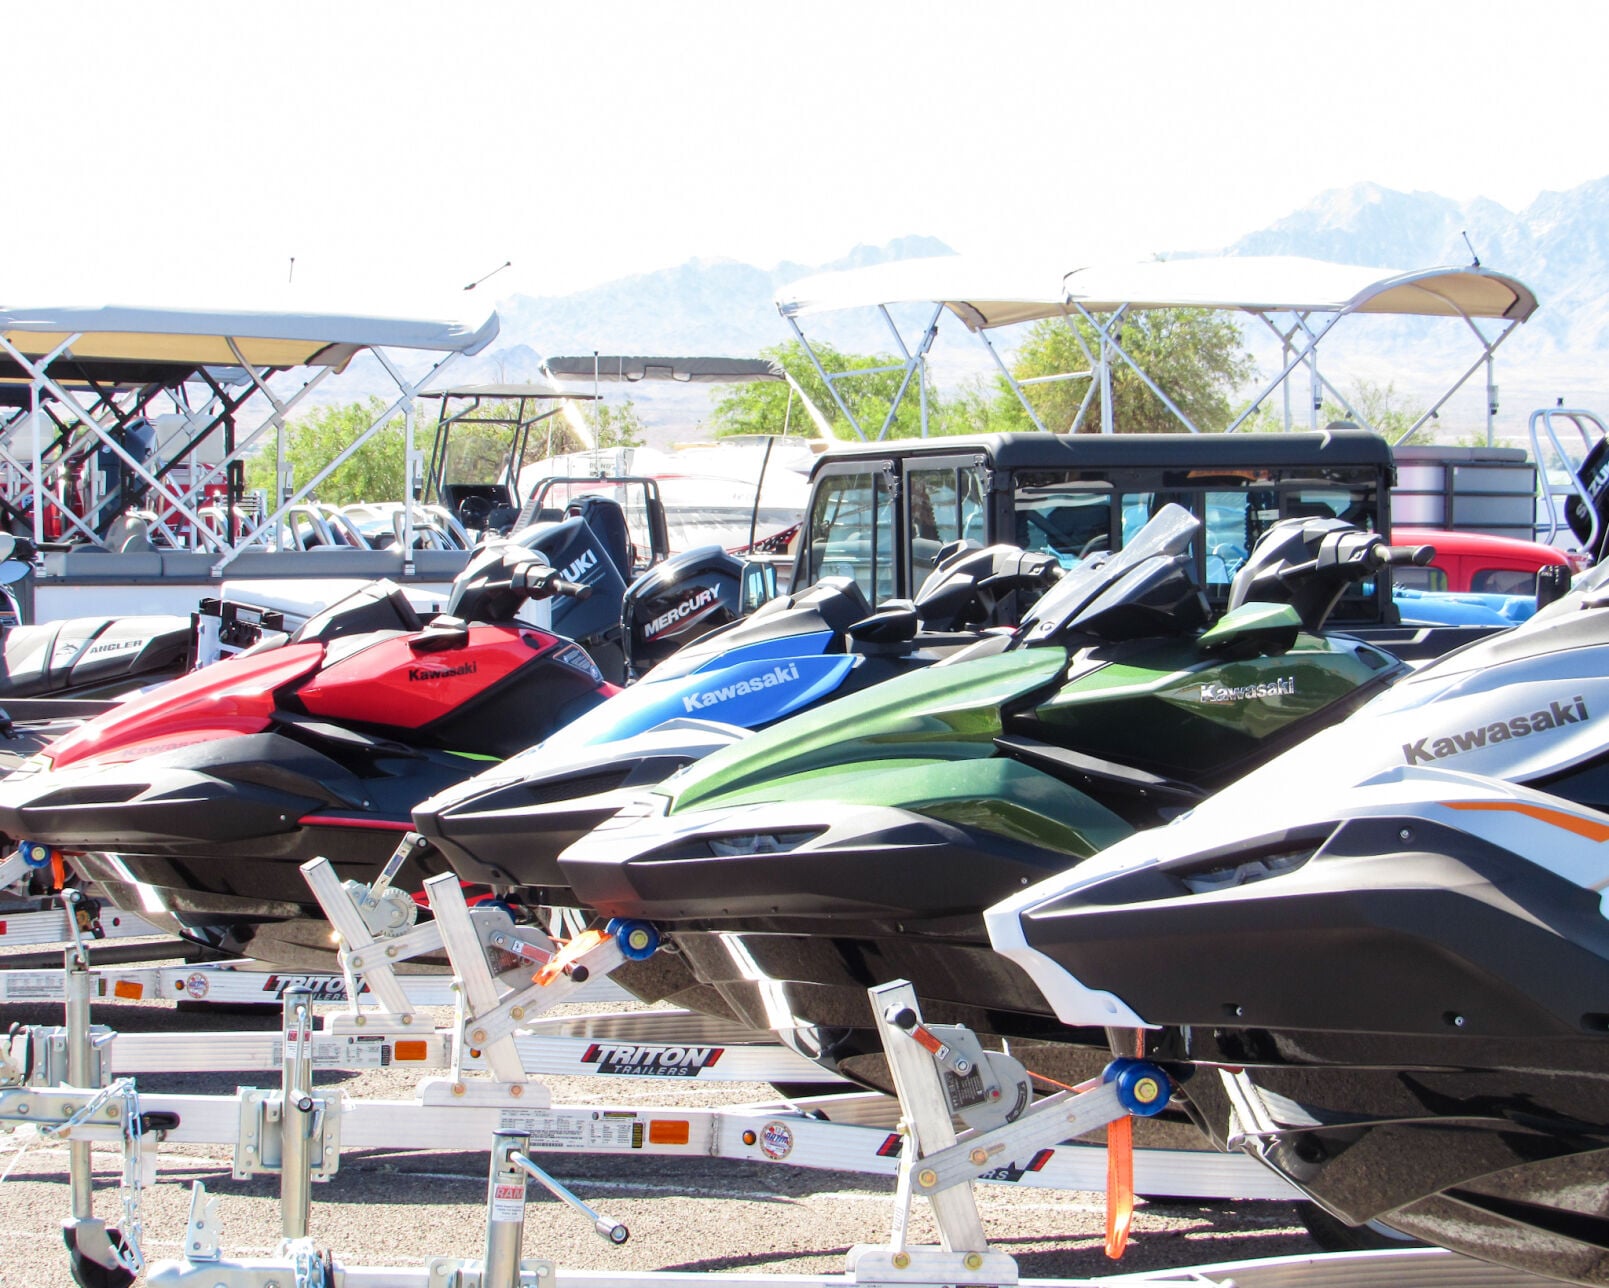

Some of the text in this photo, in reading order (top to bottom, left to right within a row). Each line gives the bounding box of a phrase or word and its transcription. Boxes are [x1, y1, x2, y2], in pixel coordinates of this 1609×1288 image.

[644, 583, 720, 637] MERCURY
[409, 661, 477, 682] Kawasaki
[682, 662, 800, 713] Kawasaki
[1200, 677, 1295, 702] Kawasaki
[1402, 696, 1589, 765] Kawasaki
[596, 1045, 712, 1067] TRITON
[614, 1065, 688, 1076] TRAILERS
[496, 1186, 524, 1199] RAM
